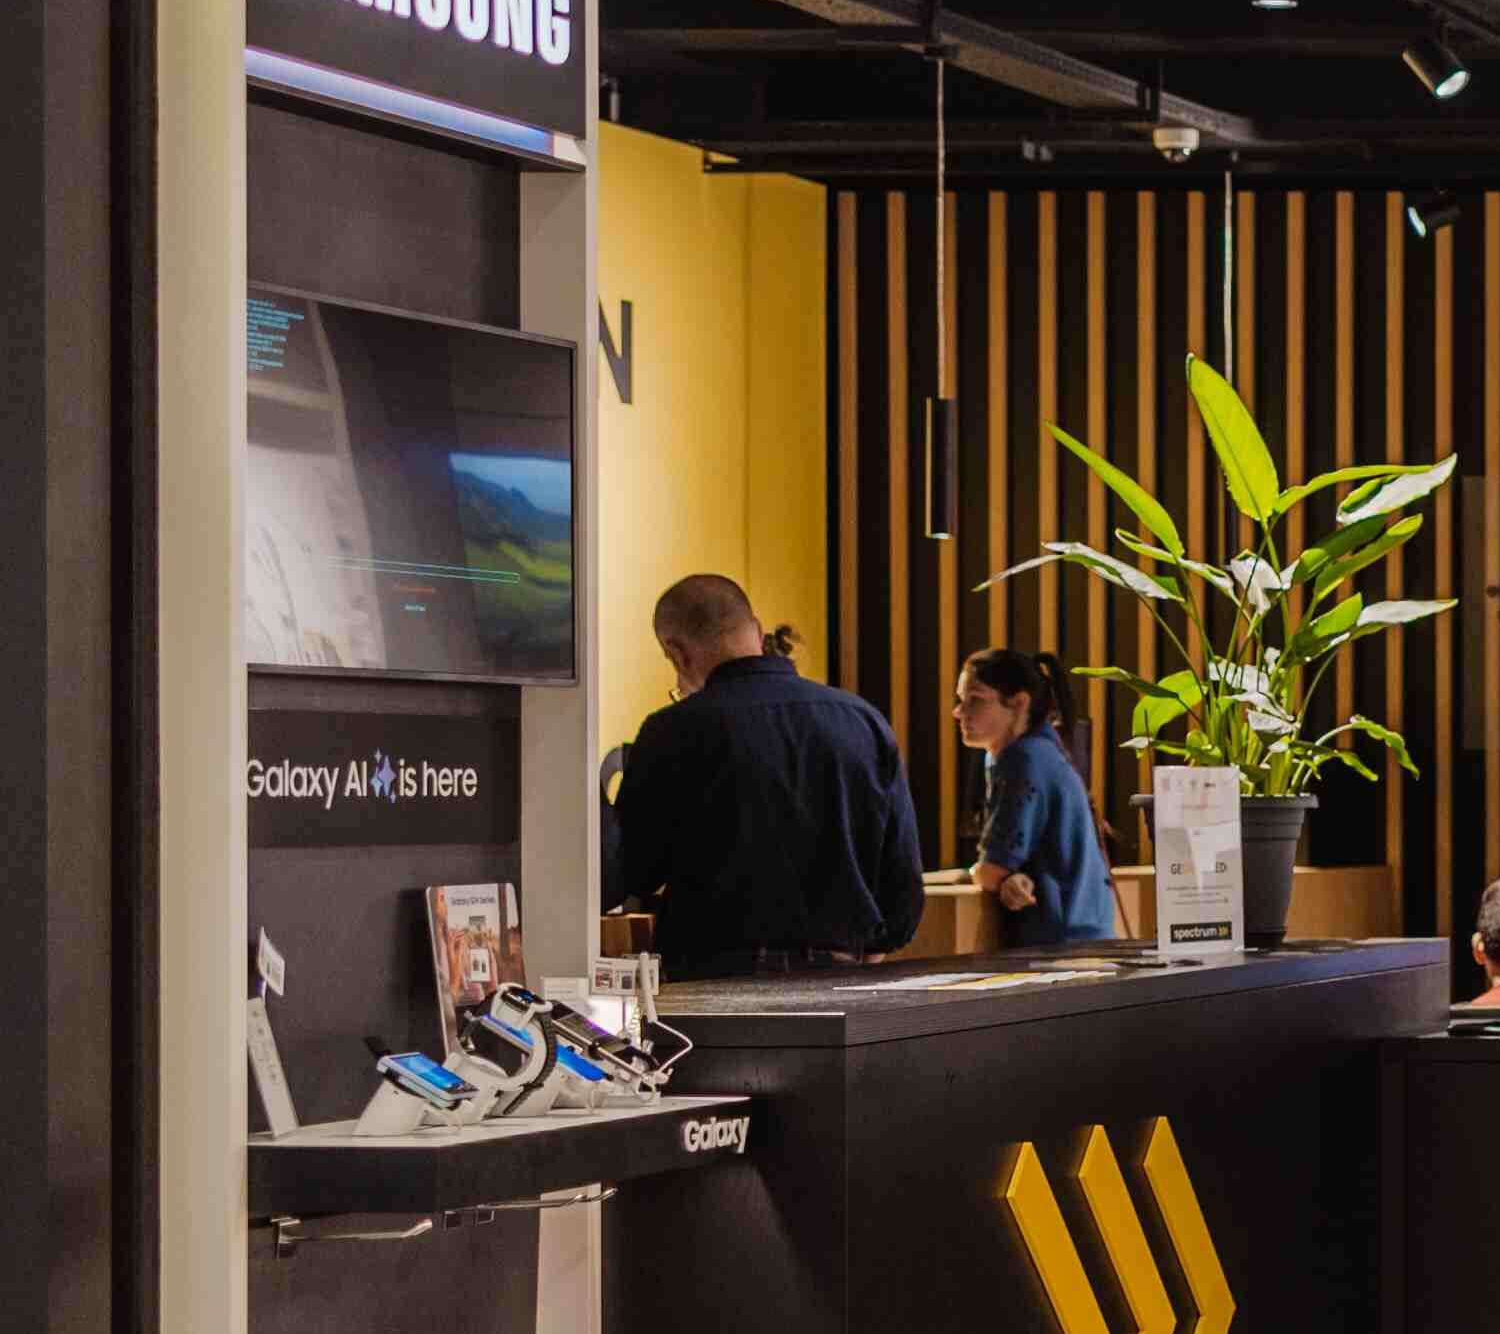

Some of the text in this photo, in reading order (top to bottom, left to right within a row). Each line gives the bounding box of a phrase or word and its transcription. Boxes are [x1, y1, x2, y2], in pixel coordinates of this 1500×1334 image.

[246, 758, 478, 810] Galaxy AI is here
[1173, 926, 1218, 942] spectrum
[684, 1115, 751, 1155] Galaxy
